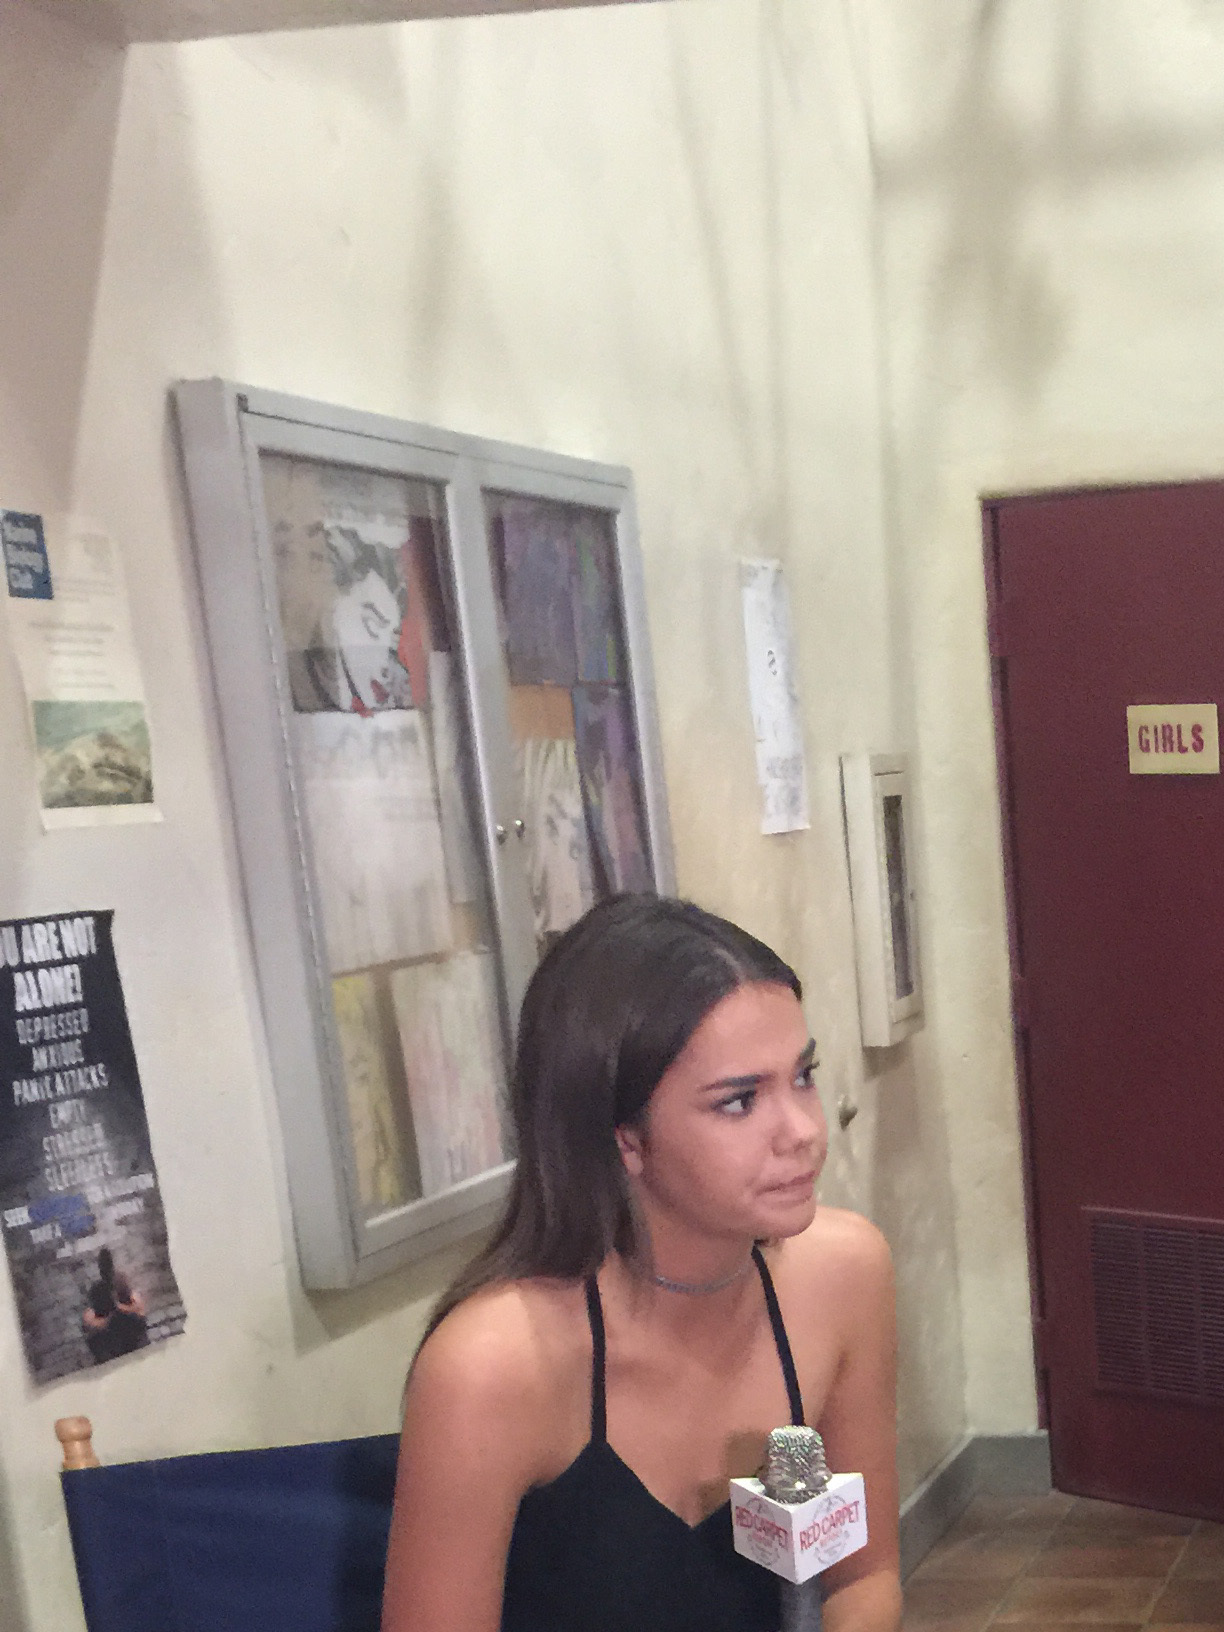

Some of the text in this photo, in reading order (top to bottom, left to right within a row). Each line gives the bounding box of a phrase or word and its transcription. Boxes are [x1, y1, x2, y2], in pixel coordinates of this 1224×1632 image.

[1138, 723, 1204, 754] GIRLS
[21, 921, 62, 963] ARE
[59, 916, 97, 958] NOT
[14, 964, 83, 1012] ALONE!
[16, 1008, 89, 1044] DEPRESSED
[12, 1062, 109, 1106] PANIC ATTACKS
[735, 1505, 755, 1529] RED
[800, 1521, 821, 1550] RED
[821, 1500, 860, 1535] CARPET
